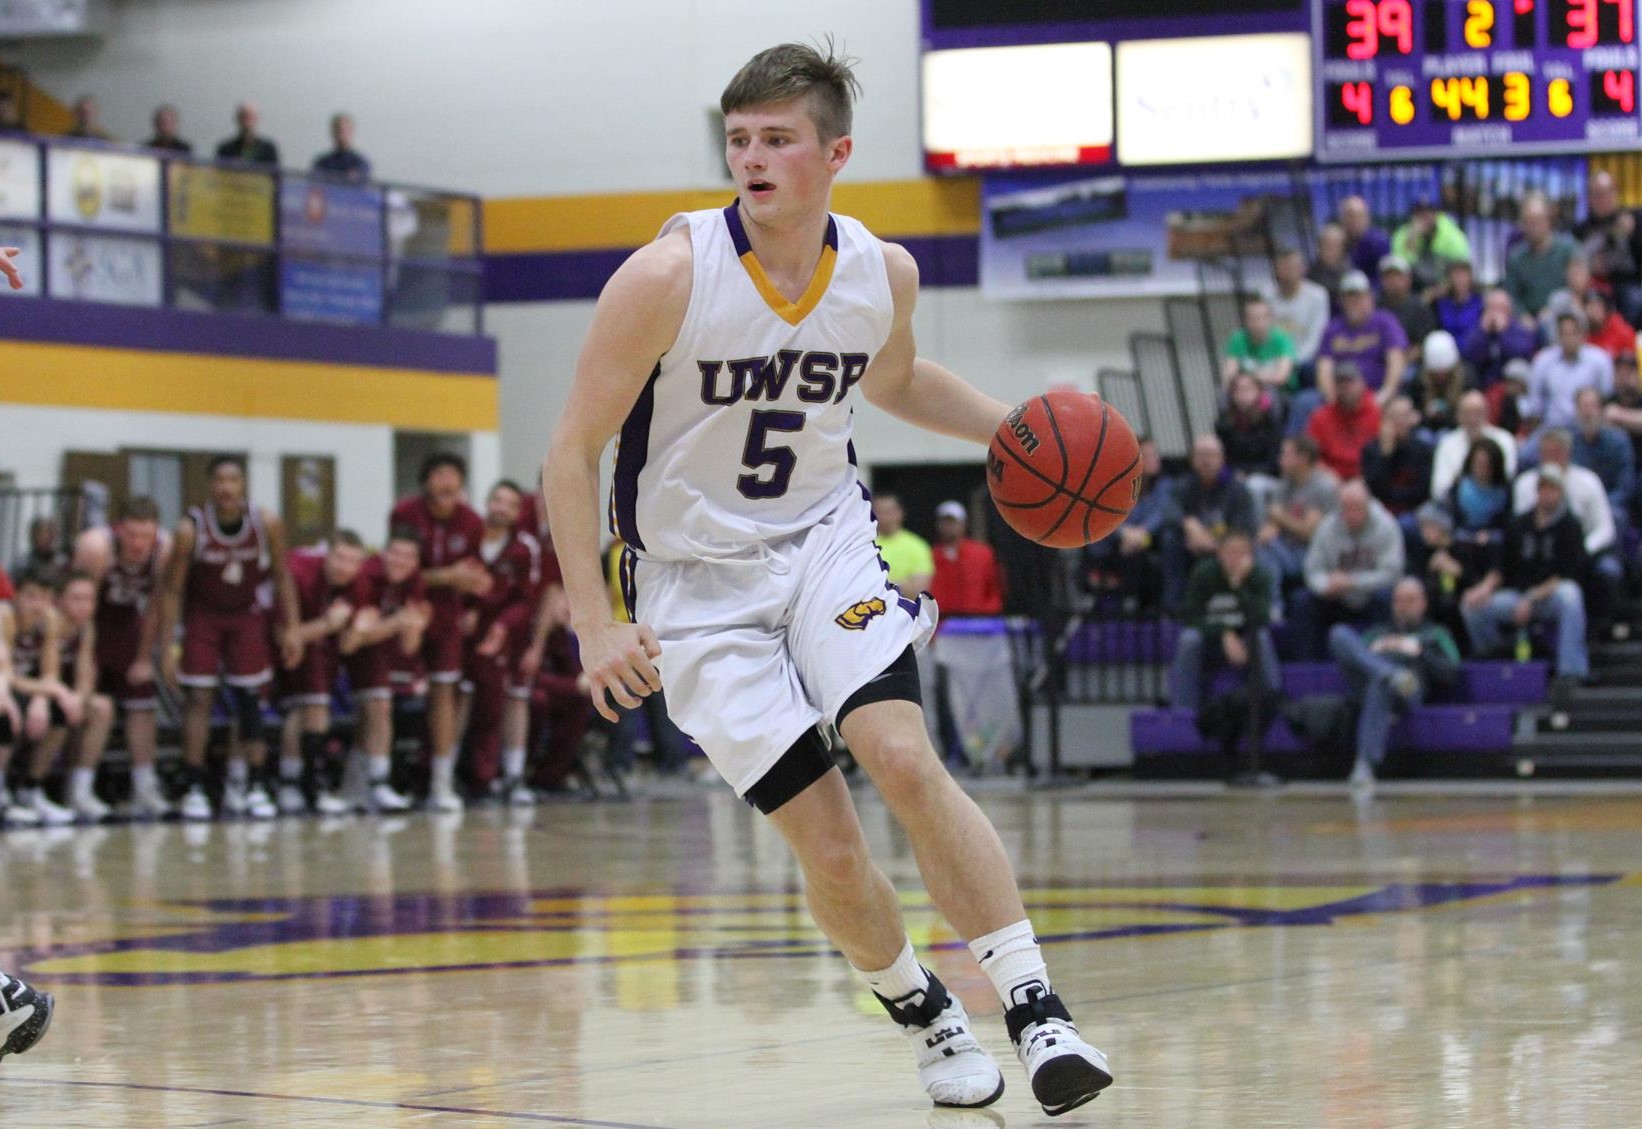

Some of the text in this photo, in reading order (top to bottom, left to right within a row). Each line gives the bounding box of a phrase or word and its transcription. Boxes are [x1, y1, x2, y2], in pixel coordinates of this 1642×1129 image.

[1346, 0, 1413, 59] 39
[1464, 0, 1495, 48] 2
[1566, 0, 1634, 49] 37
[1341, 81, 1373, 125] 4
[1389, 85, 1415, 125] 6
[1431, 76, 1489, 121] 44
[1503, 71, 1531, 121] 3
[1548, 78, 1573, 118] 6
[1603, 69, 1634, 113] 4
[697, 348, 869, 406] UWSP
[736, 408, 807, 500] 5
